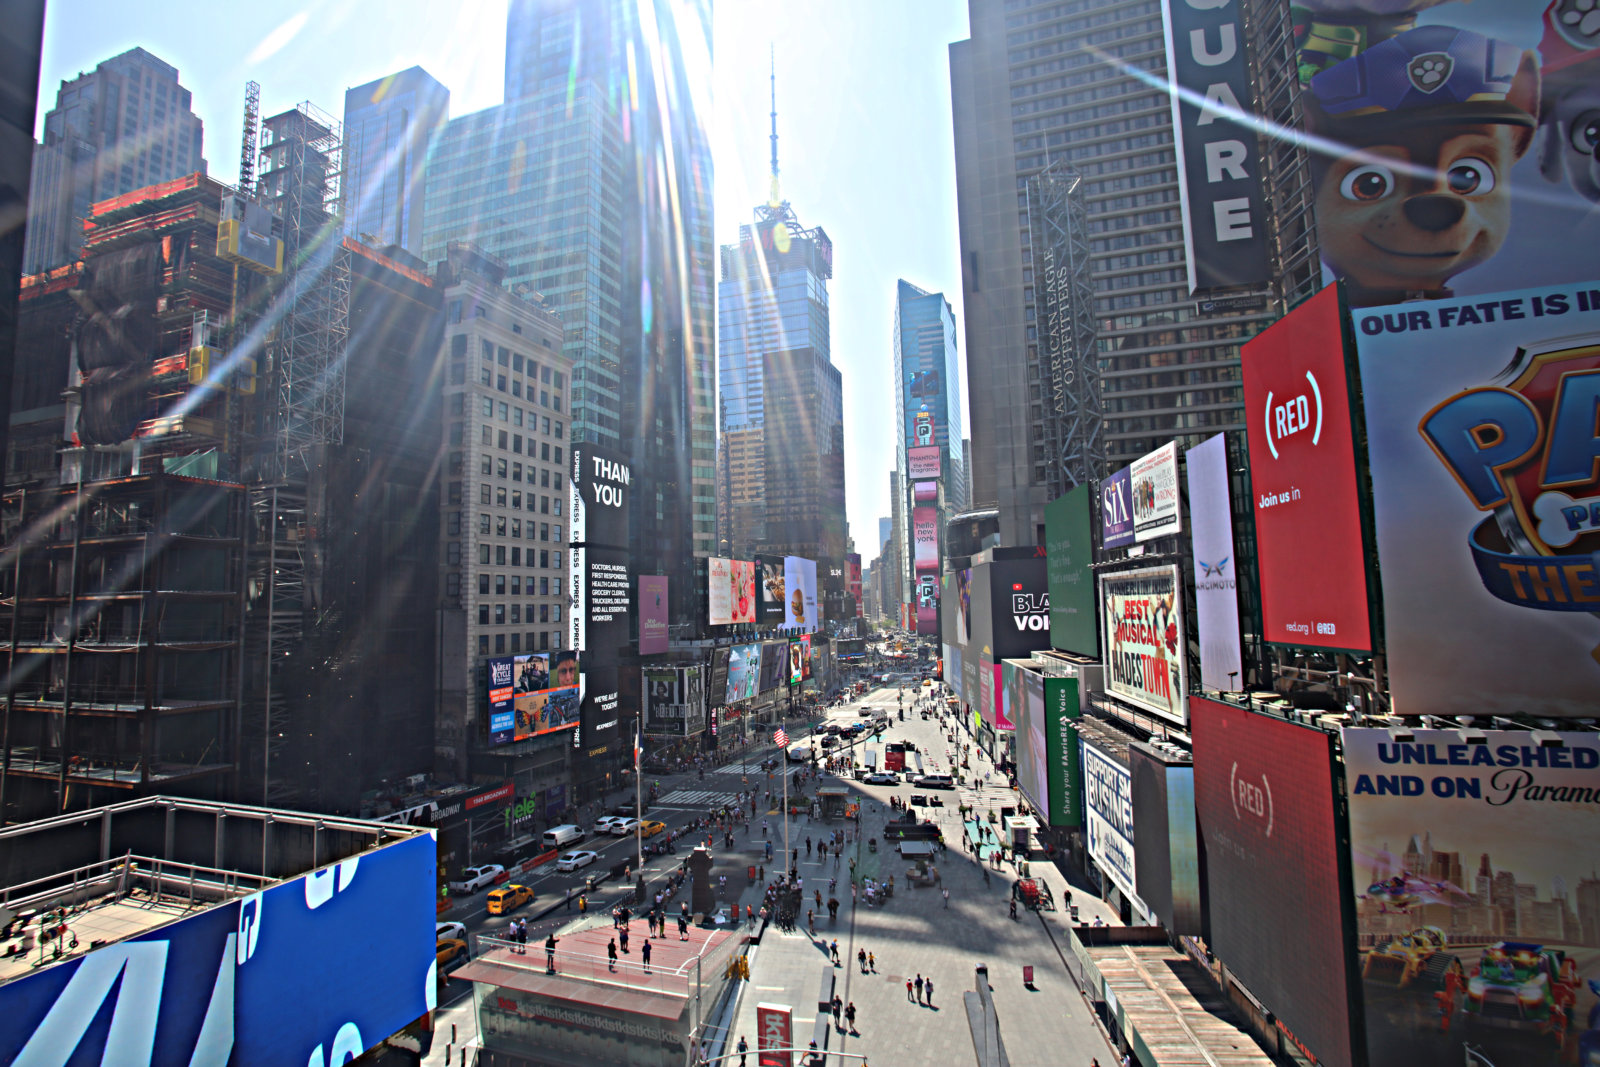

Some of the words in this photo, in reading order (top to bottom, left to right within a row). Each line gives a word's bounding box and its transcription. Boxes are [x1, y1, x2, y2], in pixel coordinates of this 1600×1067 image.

[1044, 247, 1057, 307] EAGLE
[1057, 266, 1075, 385] OUTFITTERS
[1361, 310, 1433, 336] OUR
[1438, 299, 1526, 328] FATE
[1531, 293, 1570, 317] IS
[1048, 312, 1065, 413] AMERICAN
[909, 454, 939, 462] PHANTOM
[592, 482, 622, 507] YOU
[1259, 492, 1278, 509] Join
[1279, 491, 1290, 503] us
[1291, 486, 1301, 500] in
[916, 521, 934, 529] hello
[917, 536, 934, 544] york
[1196, 580, 1236, 591] ARCIMOTO
[1500, 562, 1600, 602] THE
[1125, 600, 1150, 620] BEST
[1014, 615, 1050, 631] VOI
[1117, 622, 1161, 647] MUSICAL
[1286, 621, 1309, 635] red.org
[496, 671, 511, 679] CYCLE
[1112, 650, 1171, 699] HADESTOWN
[1060, 716, 1069, 766] #AerieREA
[1377, 742, 1600, 769] UNLEASHED
[1063, 770, 1071, 789] your
[1087, 753, 1118, 792] SUPPORT
[484, 788, 509, 801] BROADWAY
[1353, 774, 1424, 797] AND
[1431, 776, 1482, 799] ON
[430, 803, 461, 822] BROADWAY
[1088, 771, 1134, 842] BUSINE
[766, 1013, 785, 1055] tkts
